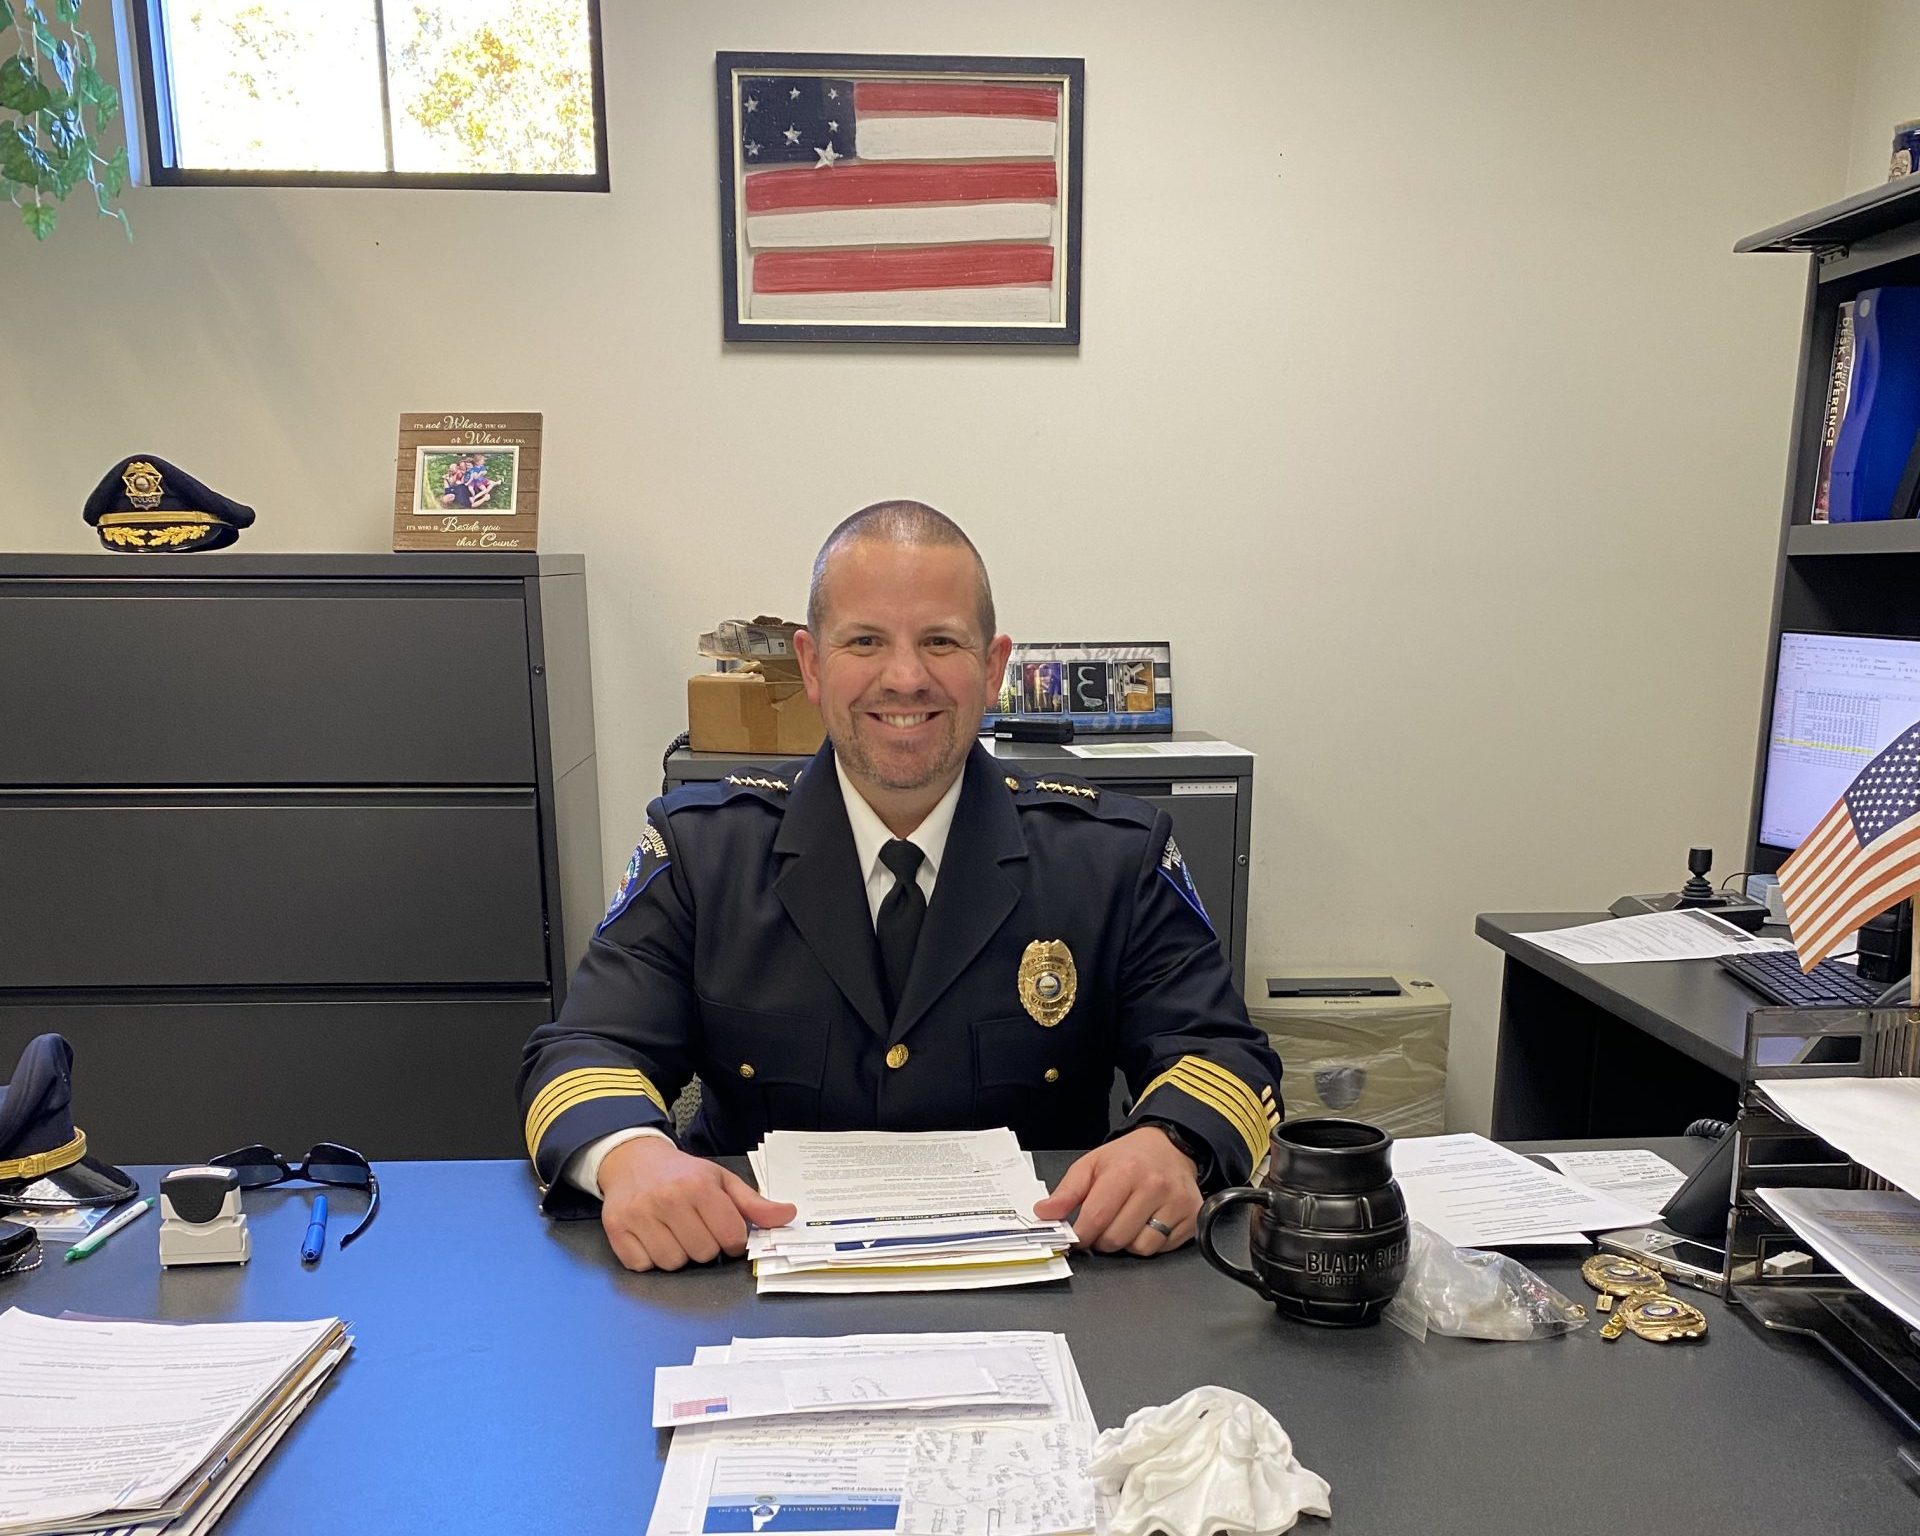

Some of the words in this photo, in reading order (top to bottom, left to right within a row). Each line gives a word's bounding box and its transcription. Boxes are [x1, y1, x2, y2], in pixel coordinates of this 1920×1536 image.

[1838, 316, 1852, 355] DESK
[1826, 361, 1844, 447] REFERENCE
[443, 415, 482, 430] Where
[464, 430, 501, 444] What
[132, 496, 159, 504] POLICE
[440, 516, 479, 533] Beside
[481, 524, 501, 536] you
[456, 536, 477, 547] that
[479, 532, 520, 548] Counts
[1305, 1250, 1370, 1275] BLACK
